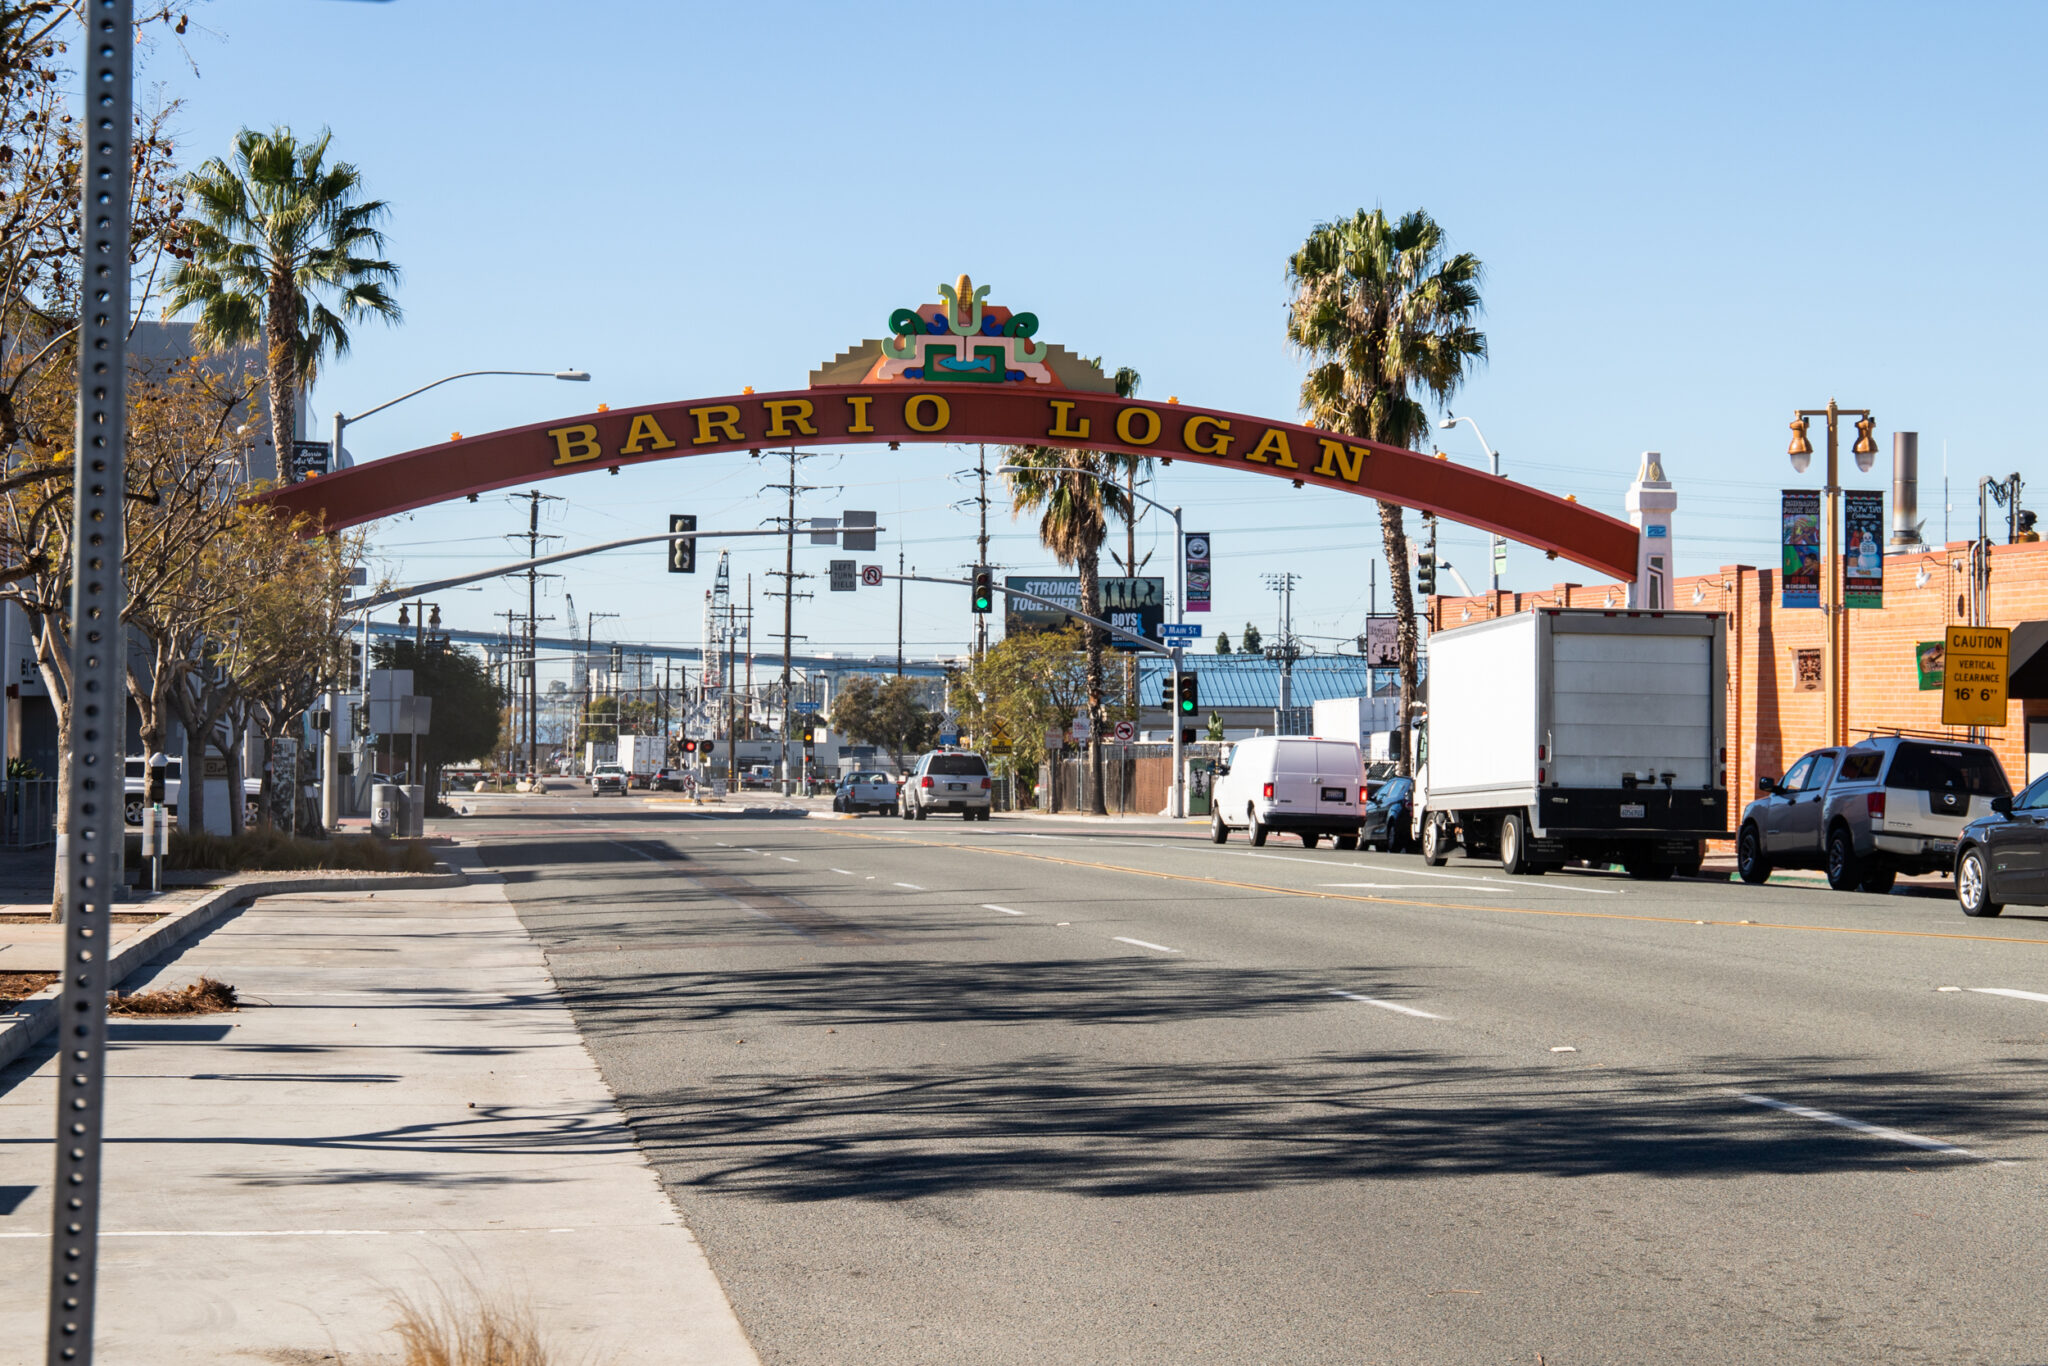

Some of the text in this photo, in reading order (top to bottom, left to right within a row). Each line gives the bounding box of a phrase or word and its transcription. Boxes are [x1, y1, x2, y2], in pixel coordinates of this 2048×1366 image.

[548, 394, 1371, 482] BARRIO LOGAN
[1023, 581, 1082, 596] STRONGE
[1112, 613, 1137, 626] BOYS
[1953, 635, 2003, 648] CAUTION
[1959, 660, 1996, 670] VERTICAL
[1954, 673, 2000, 683] CLEARANCE
[1954, 687, 1974, 700] 16'
